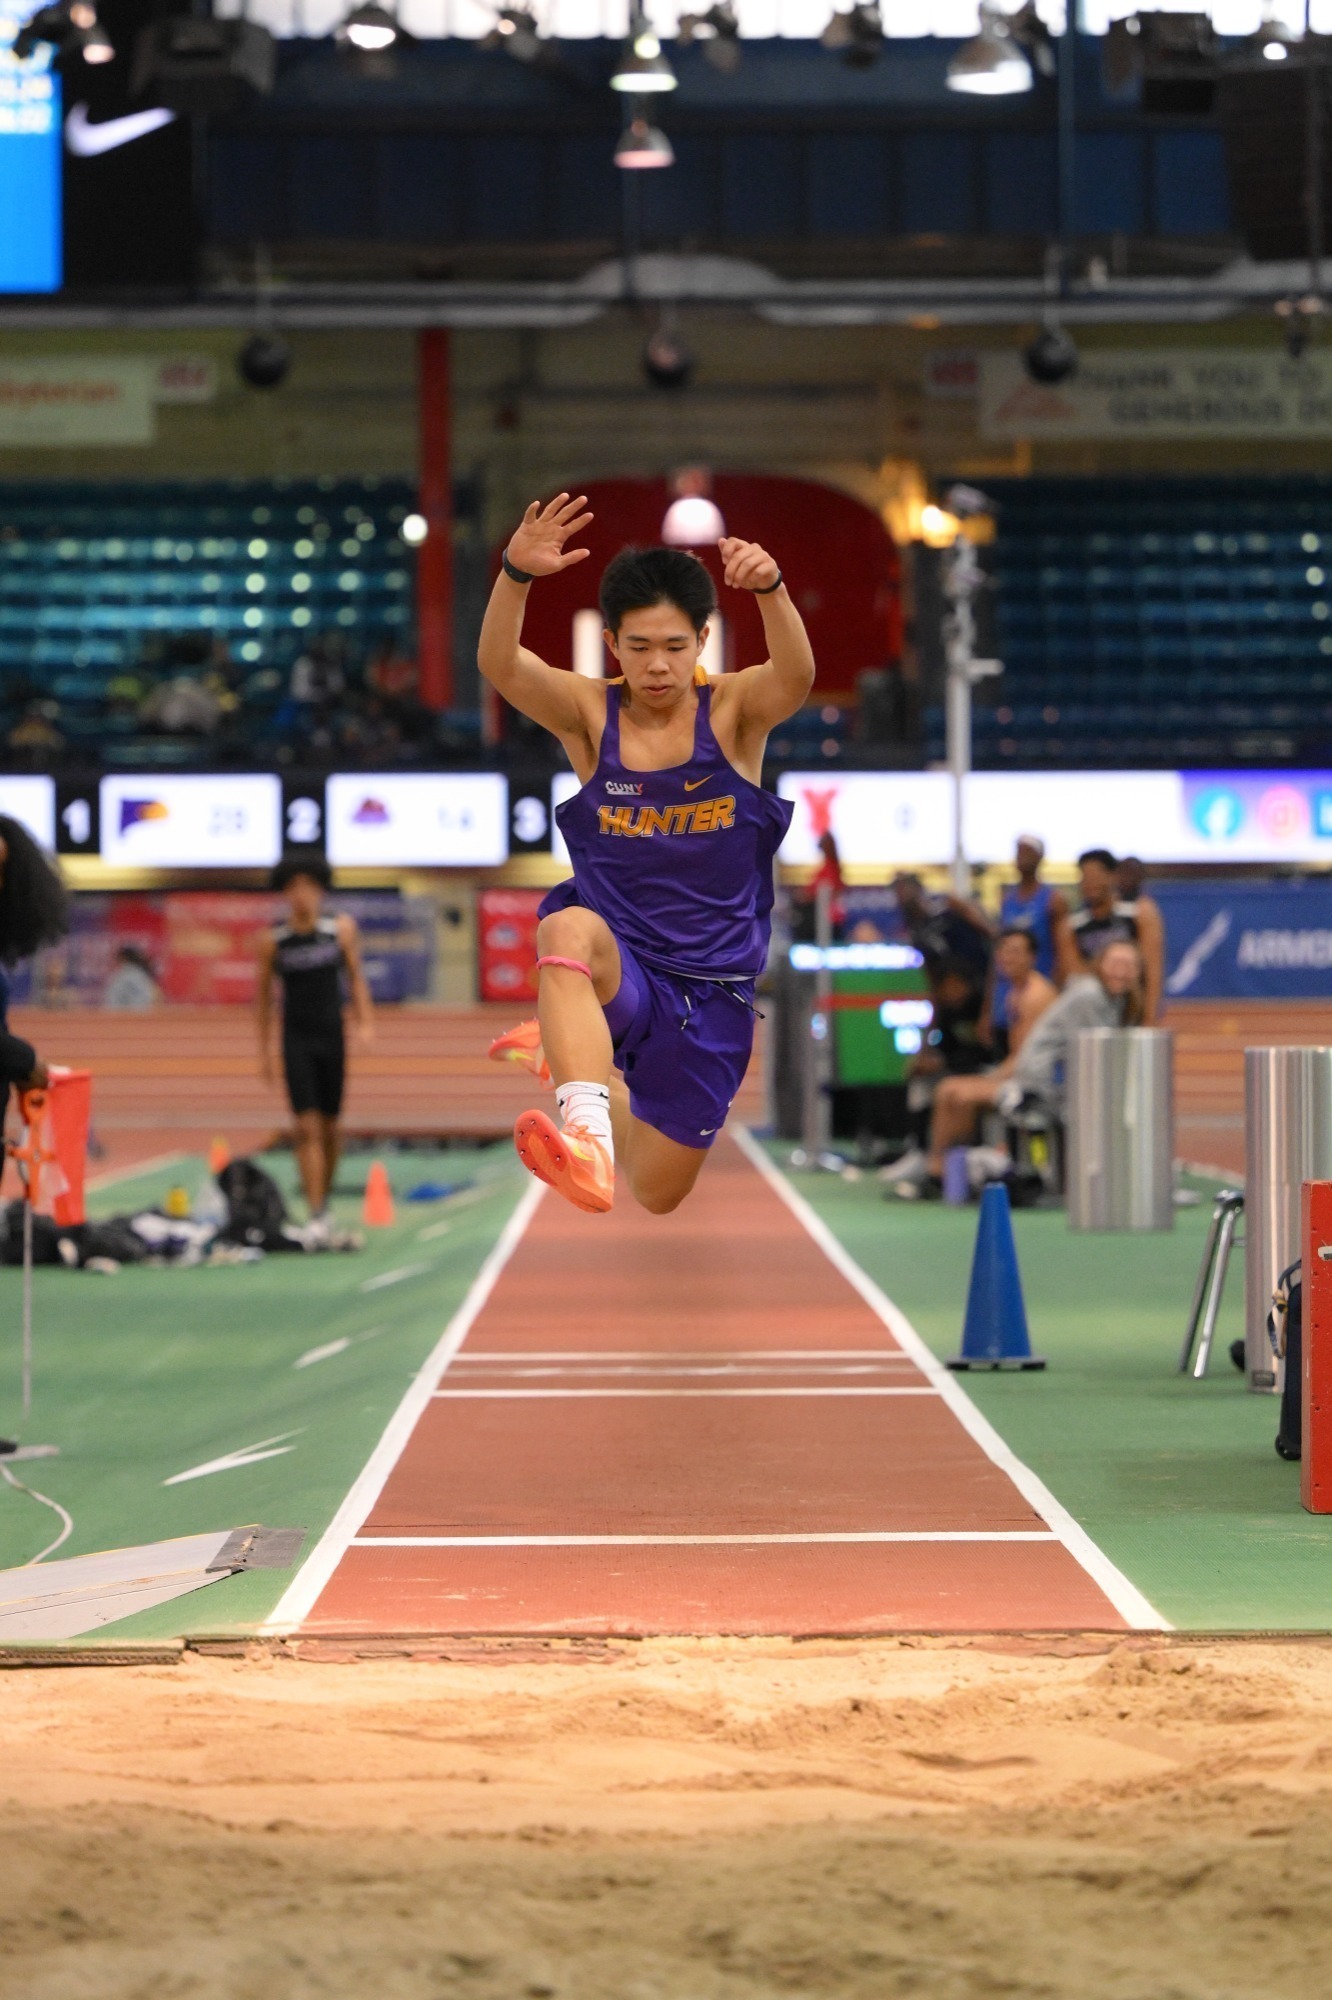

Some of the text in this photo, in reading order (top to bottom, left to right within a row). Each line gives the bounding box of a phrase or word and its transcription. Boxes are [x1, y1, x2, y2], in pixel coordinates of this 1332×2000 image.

[605, 780, 643, 795] CUNY
[62, 798, 91, 844] 1
[287, 797, 321, 843] 2
[513, 797, 548, 843] 3
[597, 795, 736, 837] HUNTER
